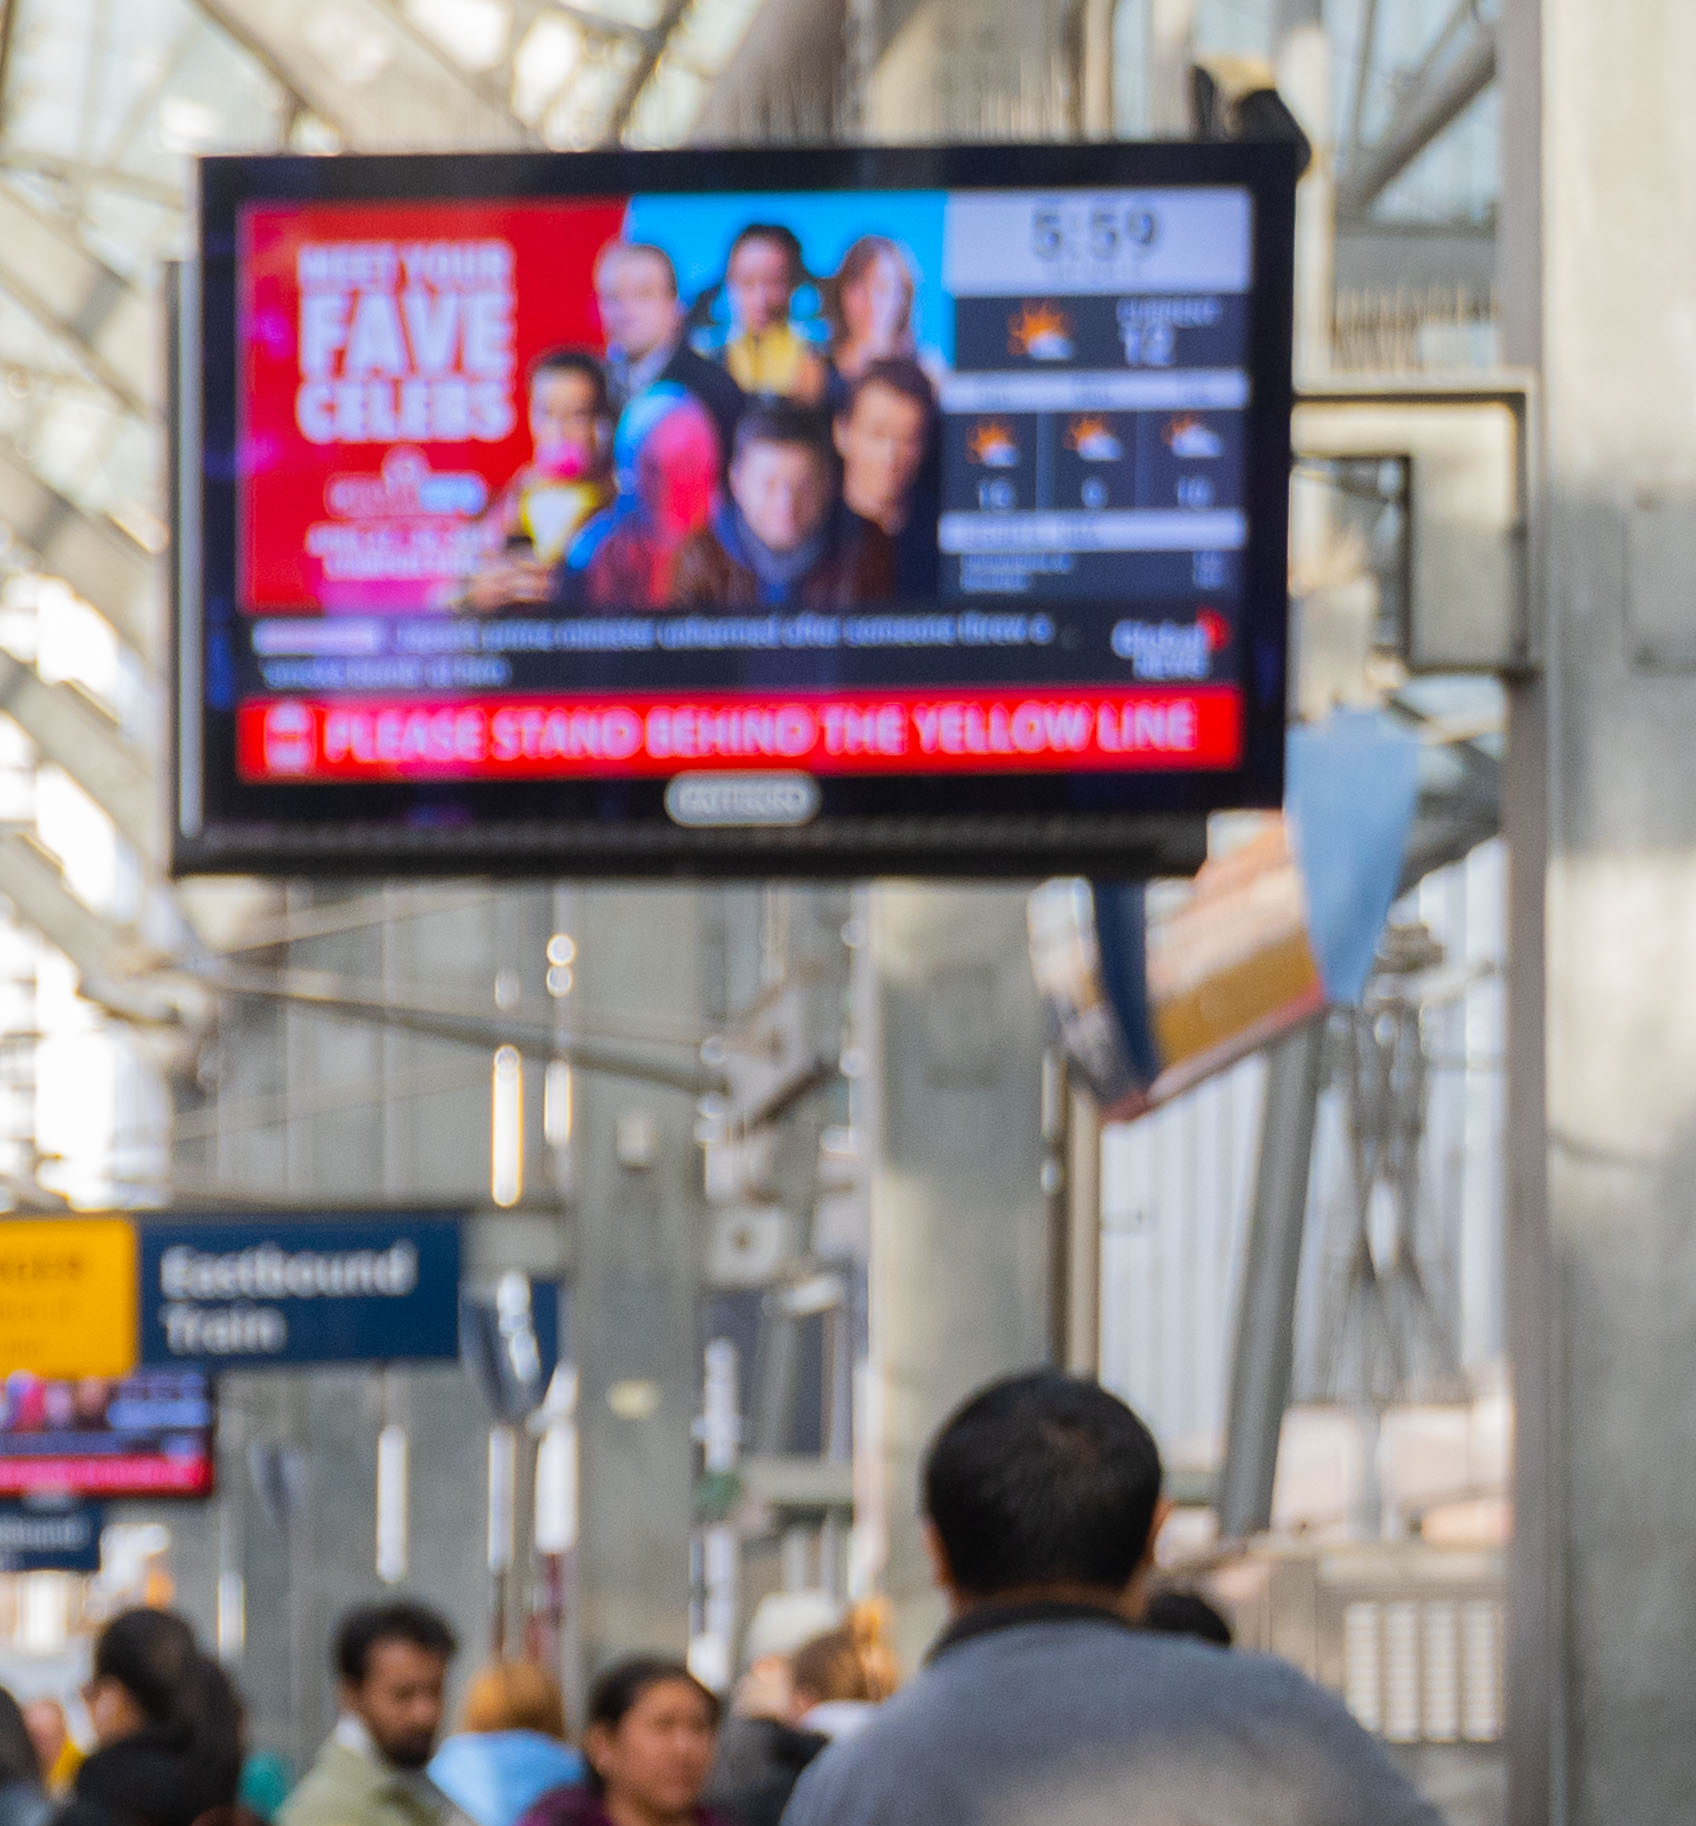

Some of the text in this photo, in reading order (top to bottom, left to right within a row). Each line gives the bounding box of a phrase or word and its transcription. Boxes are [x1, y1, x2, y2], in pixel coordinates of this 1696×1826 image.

[1031, 206, 1161, 260] 5:59
[299, 243, 515, 287] MEET YOUR
[299, 287, 515, 377] FAVE
[296, 378, 515, 441] CELEBS
[324, 698, 1198, 762] PLEASE STAND BEHIND THE YELLOW LINE
[161, 1239, 418, 1299] Eastbound
[159, 1302, 287, 1353] Train
